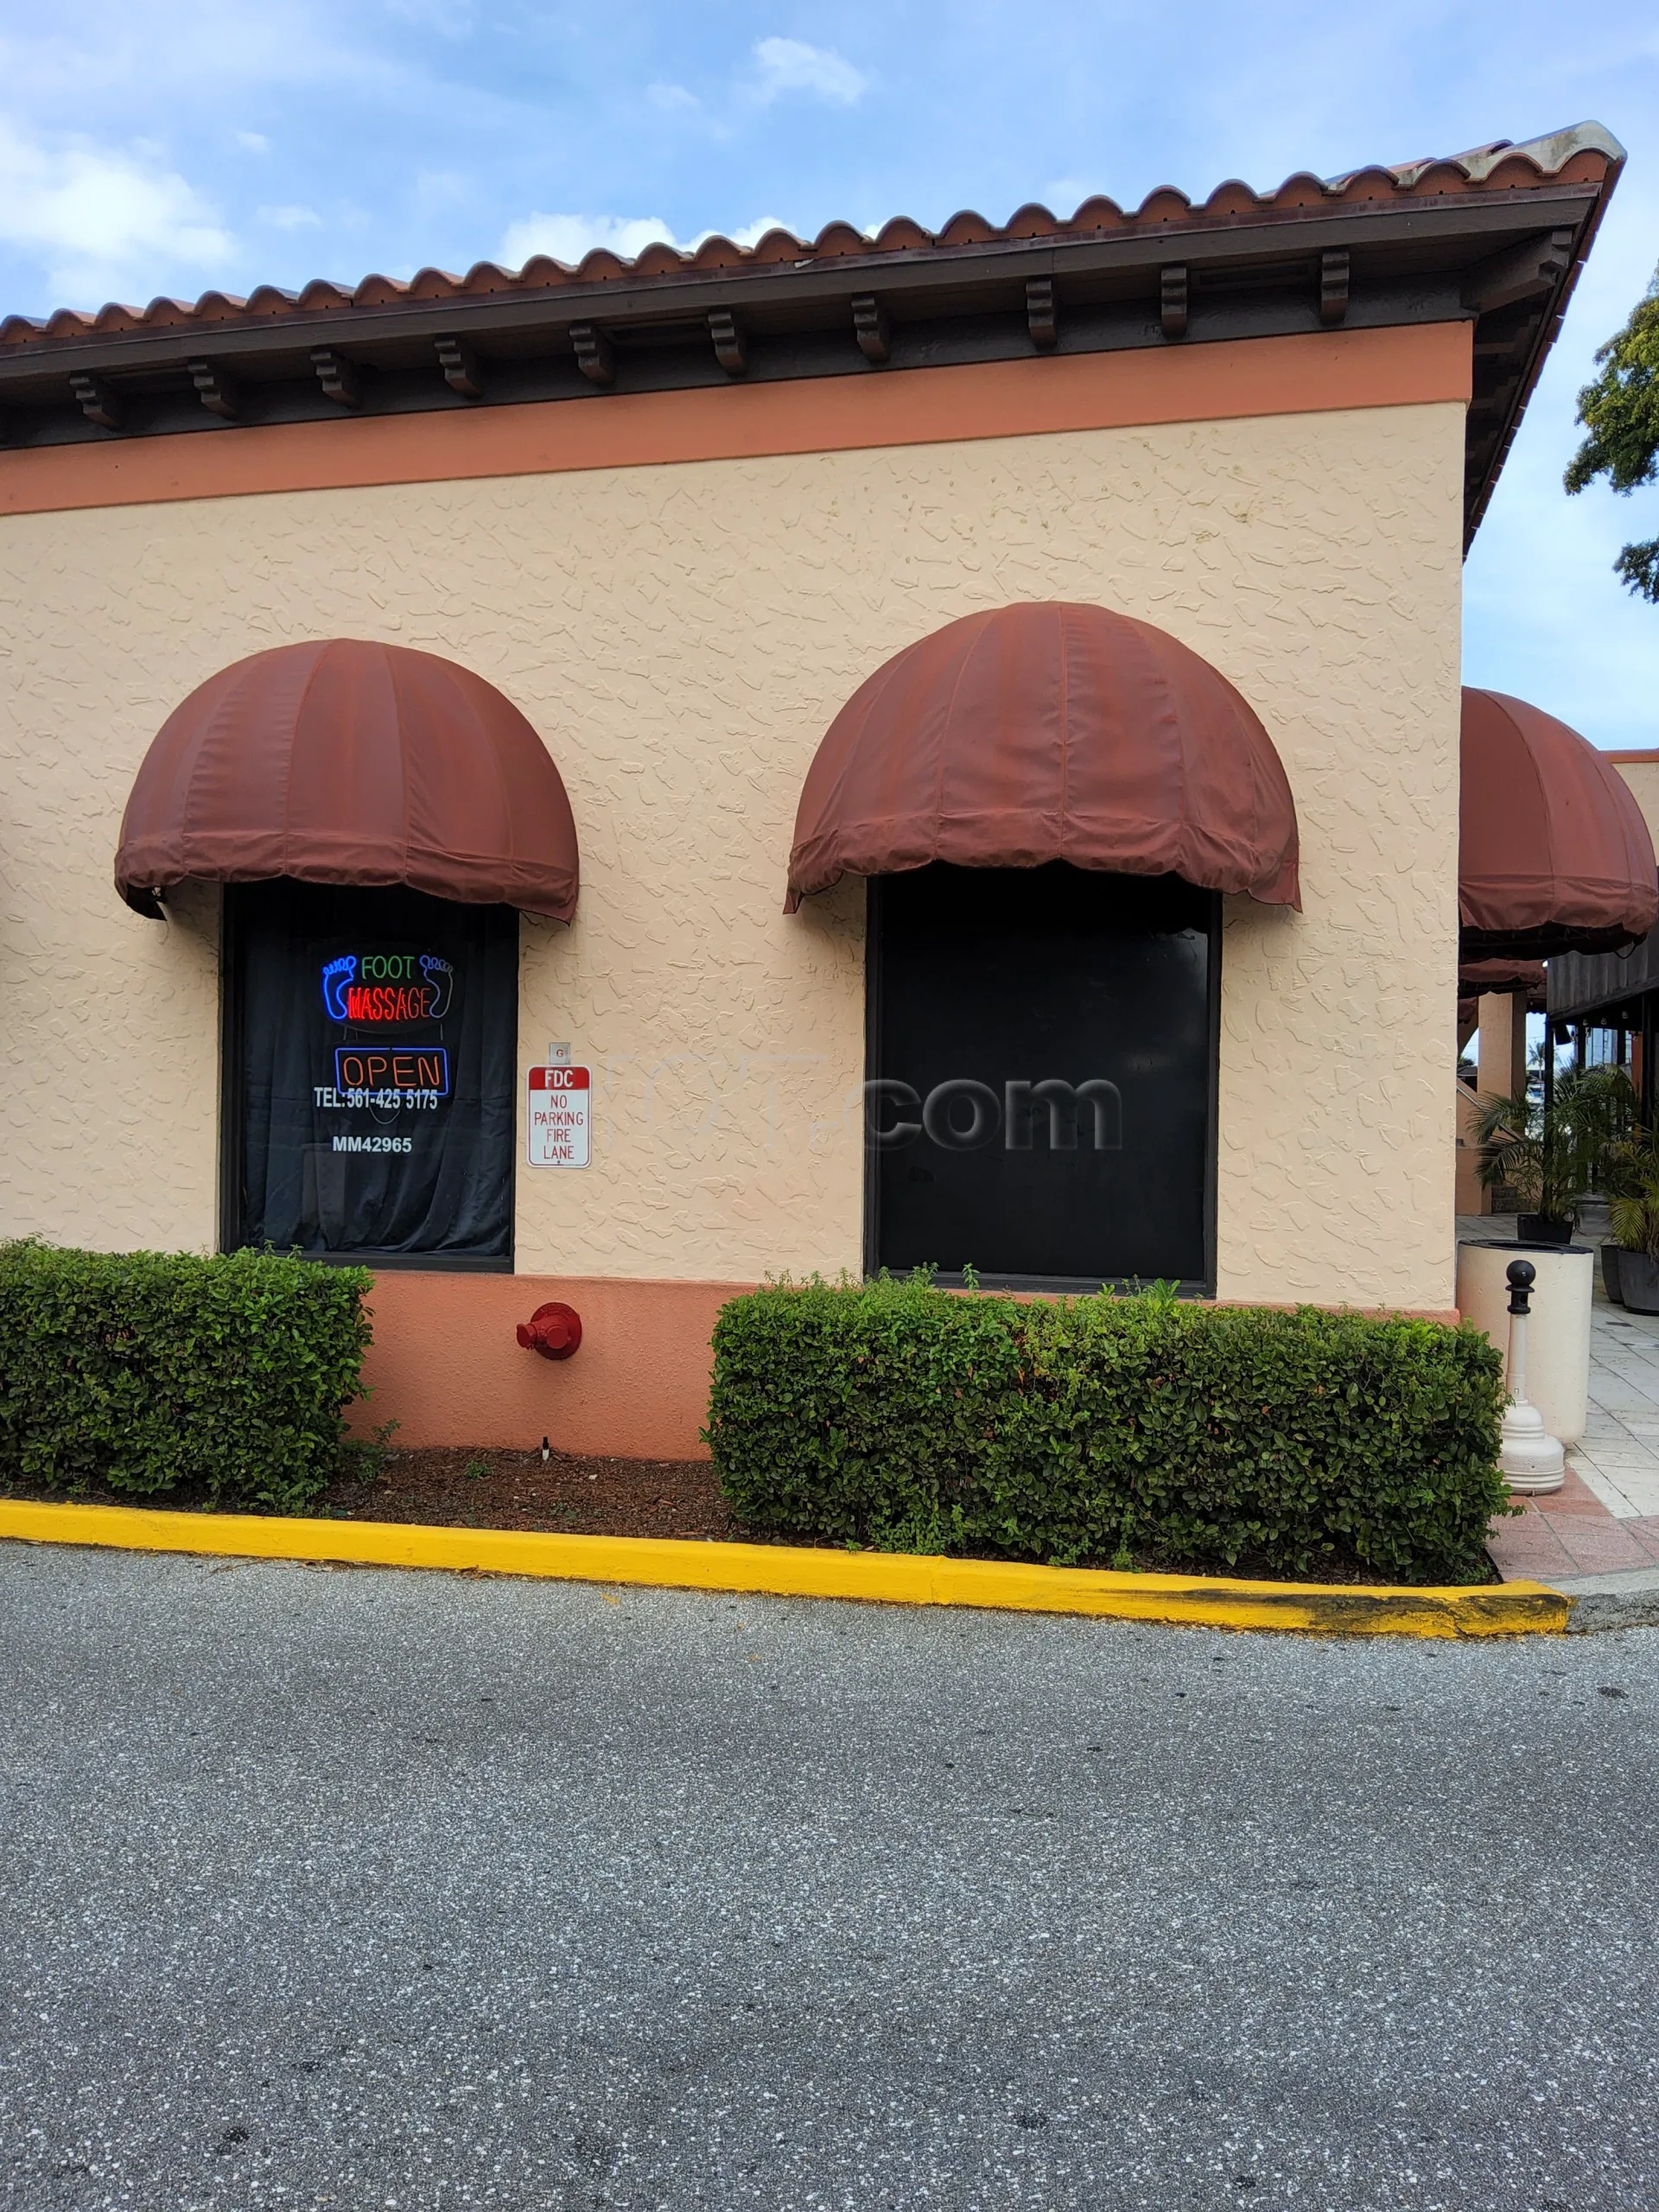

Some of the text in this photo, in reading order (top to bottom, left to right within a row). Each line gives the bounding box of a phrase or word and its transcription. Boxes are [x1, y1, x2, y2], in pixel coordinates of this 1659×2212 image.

[361, 955, 416, 980] FOOT
[347, 987, 431, 1020] MASSAGE
[556, 1049, 564, 1058] G
[343, 1056, 440, 1087] OPEN
[544, 1069, 574, 1088] FDC
[406, 1089, 438, 1110] 5175
[550, 1095, 567, 1109] NO
[534, 1111, 584, 1126] PARKING
[333, 1135, 412, 1153] MM42965
[547, 1128, 571, 1142] FIRE
[543, 1146, 575, 1160] LANE
